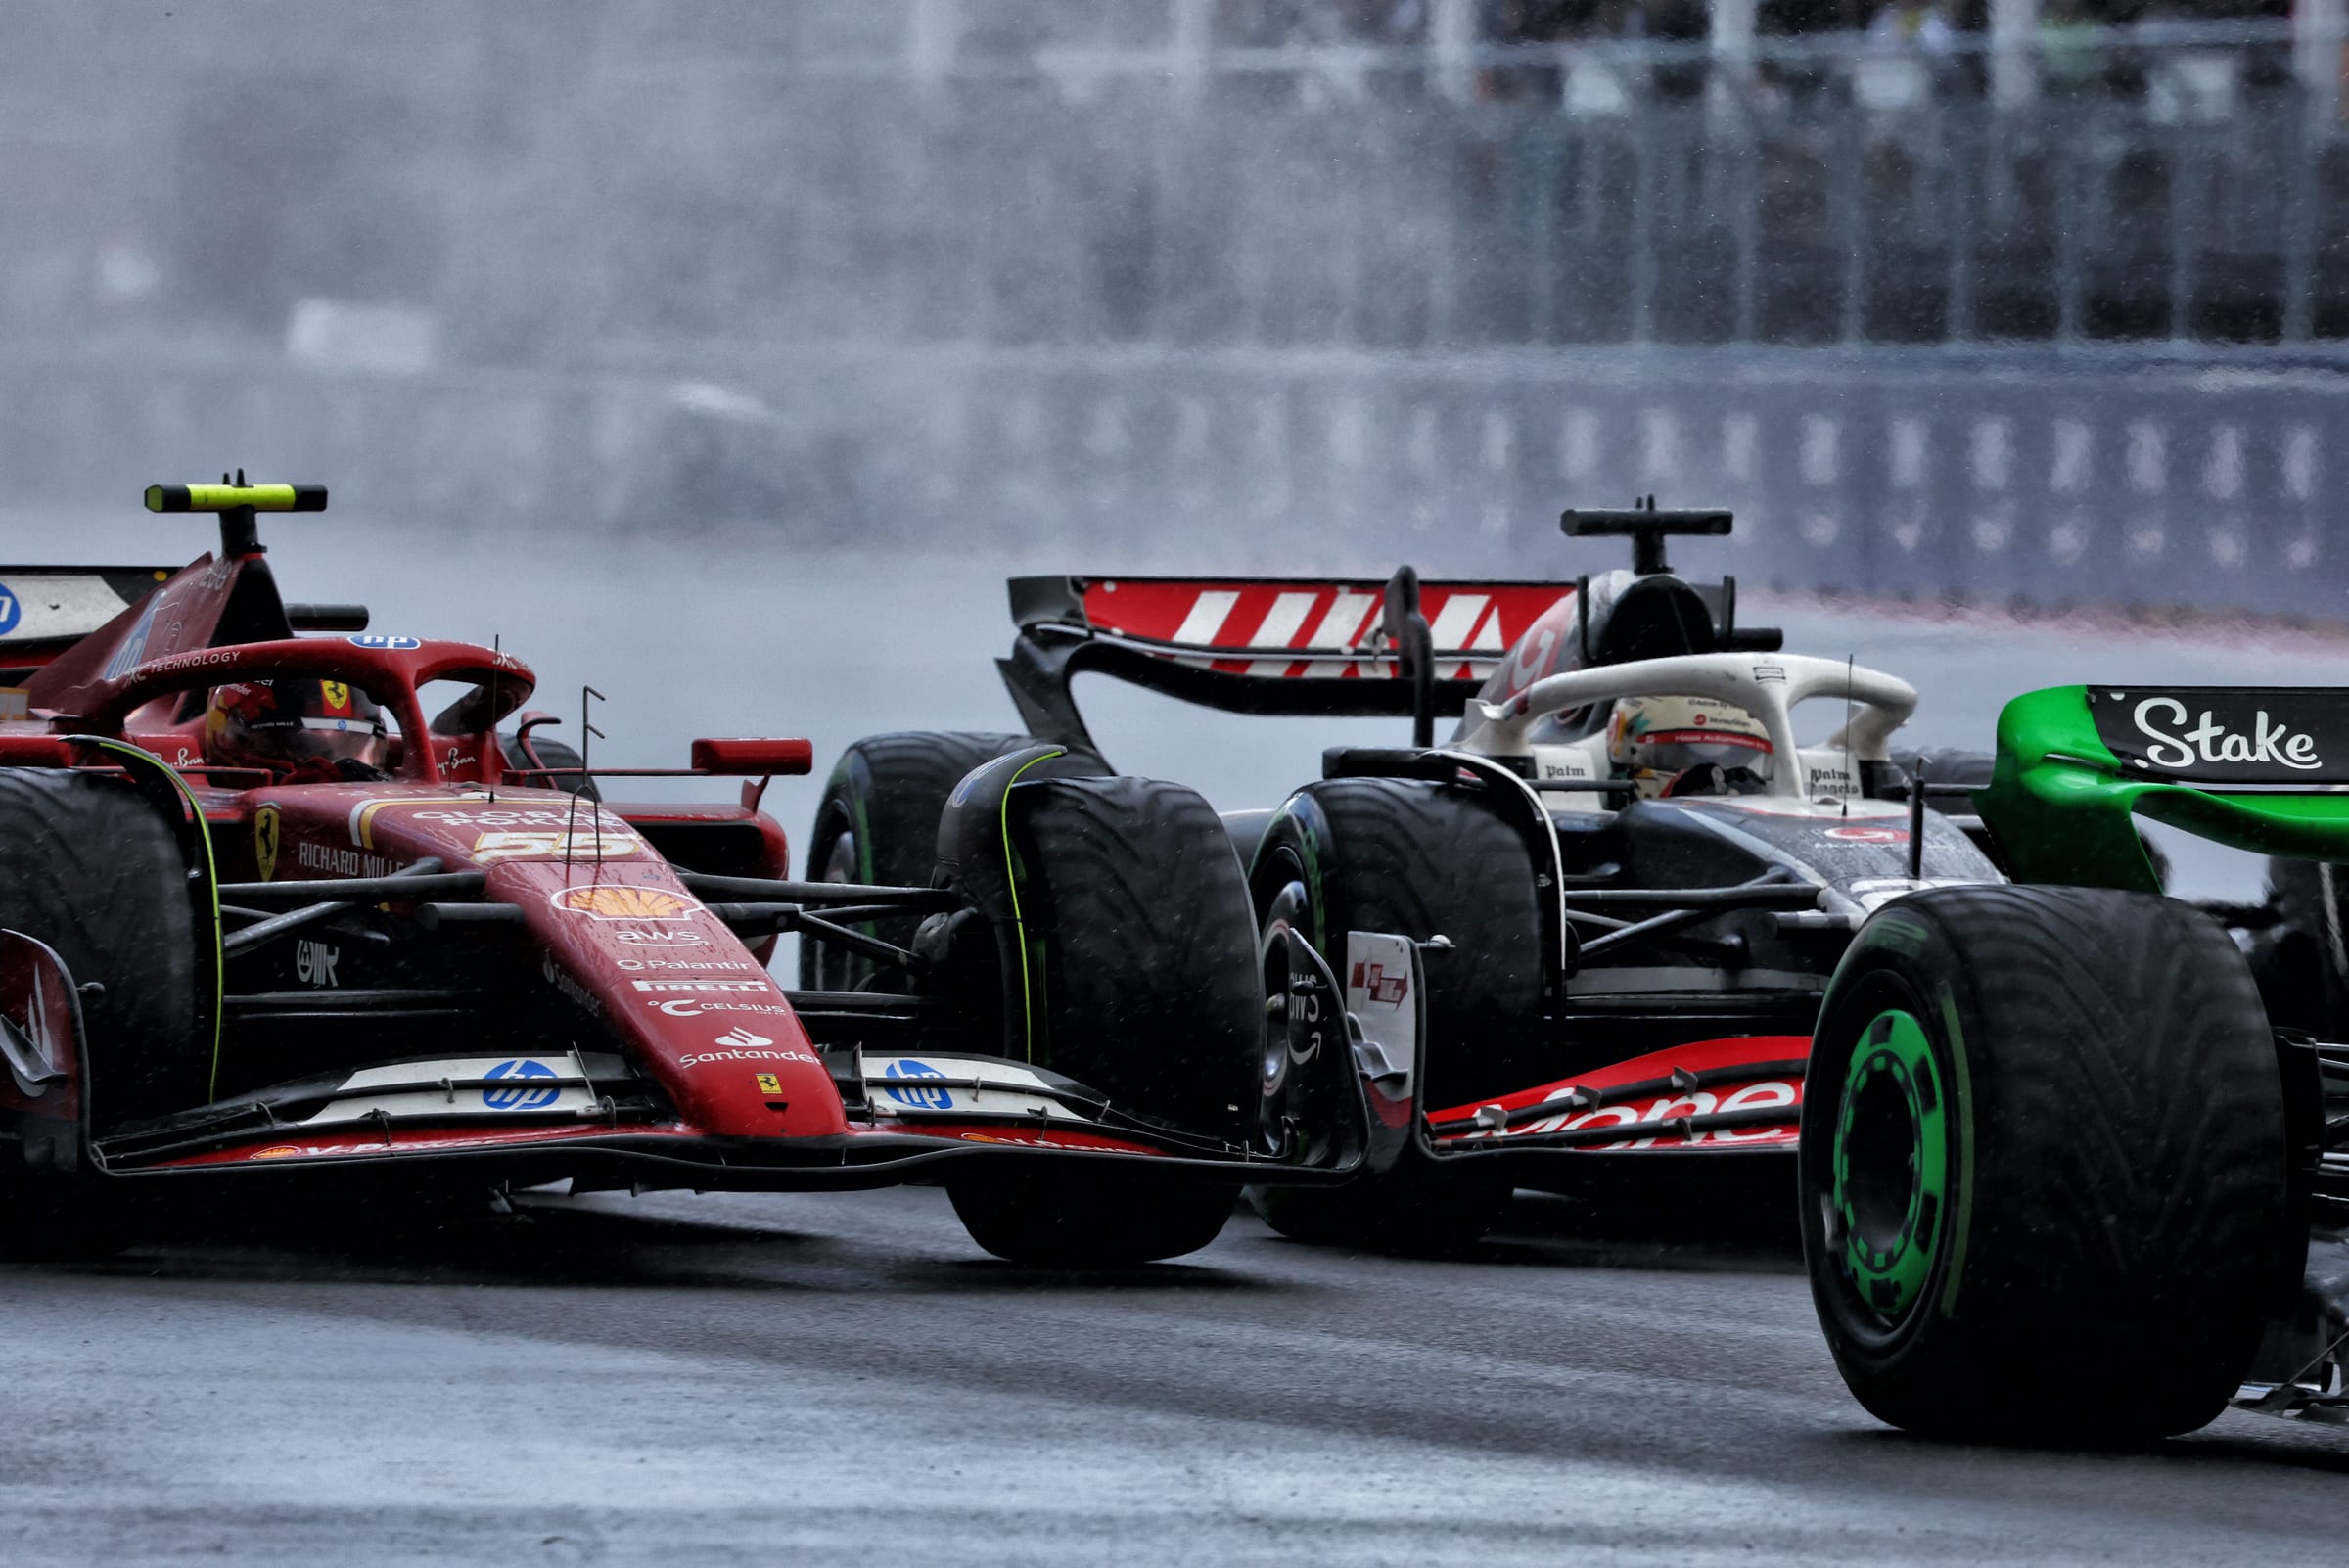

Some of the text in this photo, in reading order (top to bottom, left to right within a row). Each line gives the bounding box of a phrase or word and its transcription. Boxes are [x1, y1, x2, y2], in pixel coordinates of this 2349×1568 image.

[151, 651, 240, 673] TECHNOLOGY
[2133, 697, 2323, 769] Stake
[1545, 764, 1585, 779] Palm
[1811, 767, 1852, 782] Palm
[412, 810, 622, 820] GLOBAL
[443, 817, 625, 827] POKER
[472, 832, 642, 863] 55
[299, 841, 359, 877] RICHARD
[646, 960, 751, 970] Palantir
[631, 980, 769, 992] PIRELLI
[700, 1003, 785, 1013] CELSIUS
[679, 1049, 822, 1069] Santander
